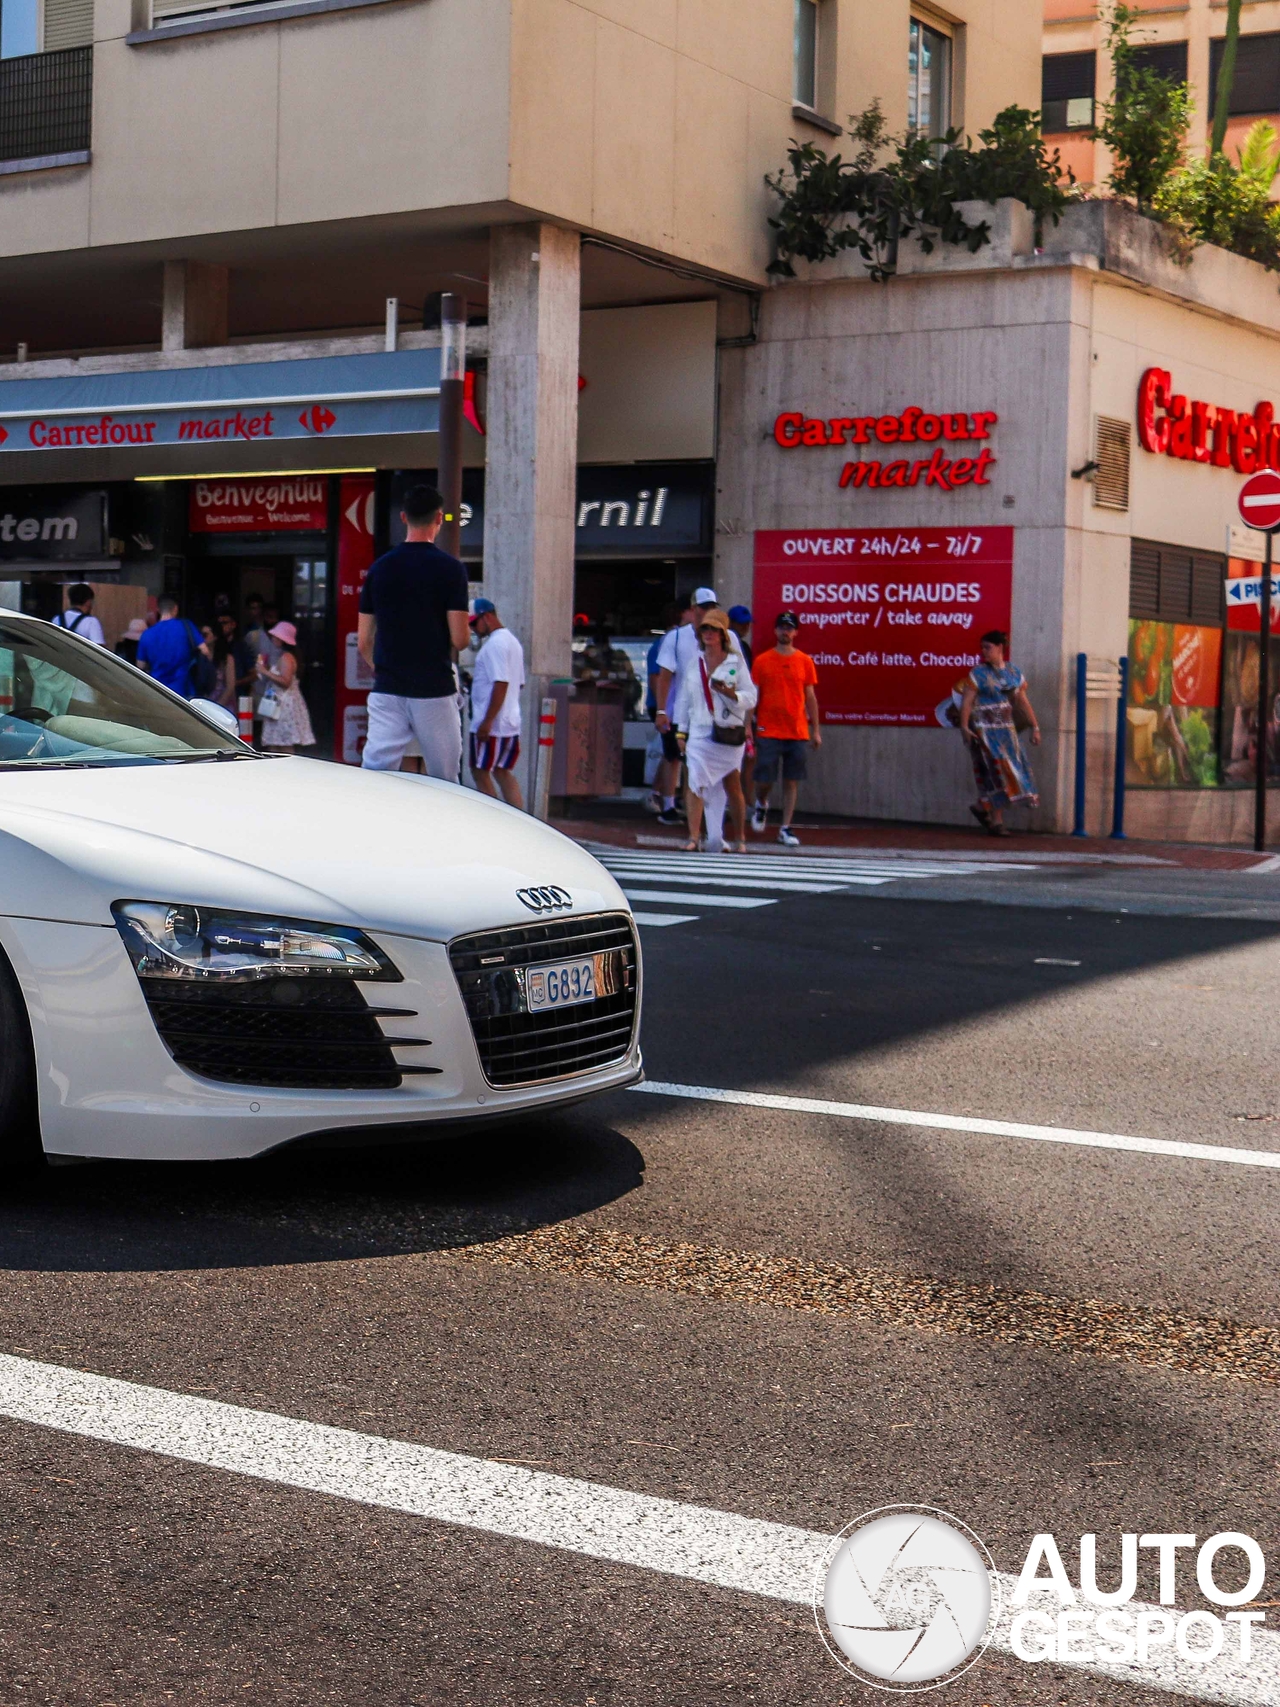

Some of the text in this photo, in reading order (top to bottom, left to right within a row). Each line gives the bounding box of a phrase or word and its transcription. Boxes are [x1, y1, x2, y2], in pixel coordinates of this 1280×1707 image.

[29, 411, 275, 447] Carrefour market
[774, 406, 997, 448] Carrefour
[838, 447, 996, 491] market
[267, 512, 311, 523] Welcome
[577, 487, 668, 527] rnil
[782, 537, 856, 556] OUVERT
[860, 534, 921, 557] 24h/24
[946, 532, 983, 557] 7j/7
[781, 582, 981, 603] BOISSONS CHAUDES
[799, 610, 870, 629] emporter
[887, 608, 923, 626] take
[927, 610, 973, 630] away
[848, 650, 879, 666] Café
[881, 651, 917, 669] latte,
[920, 651, 981, 667] Chocolat
[547, 965, 593, 1003] G892
